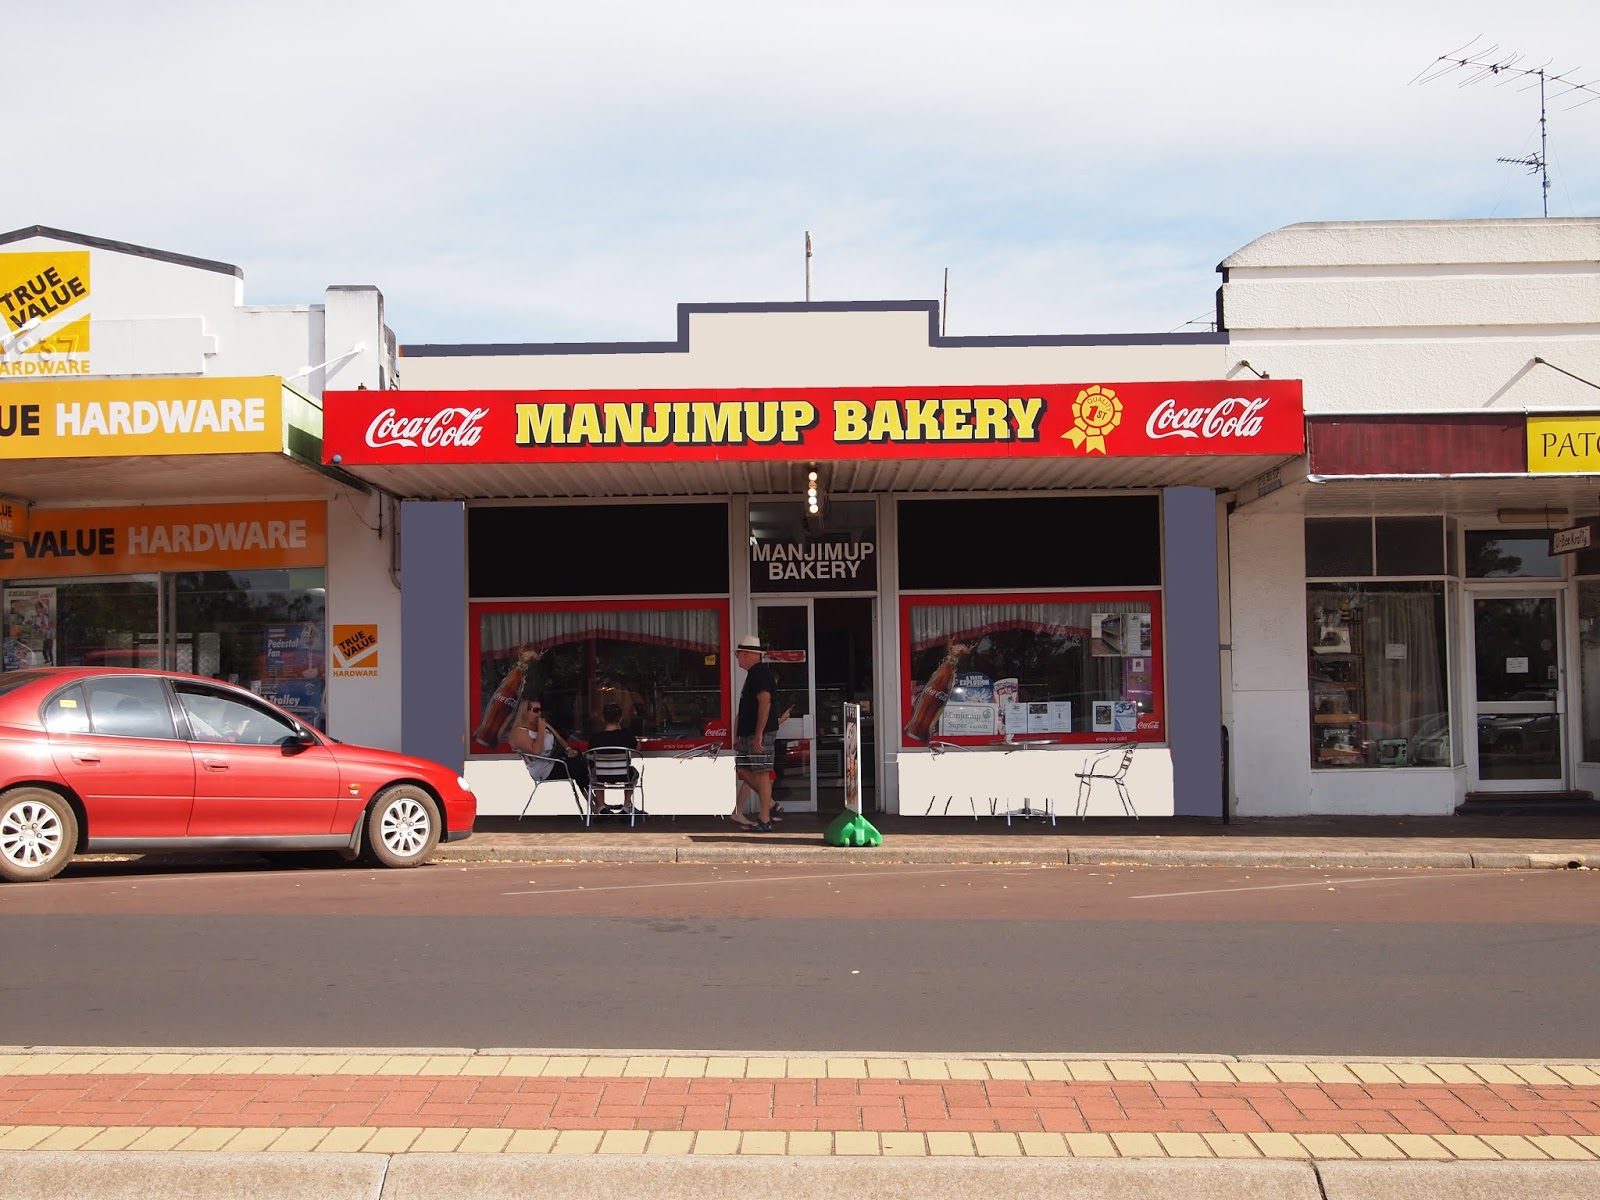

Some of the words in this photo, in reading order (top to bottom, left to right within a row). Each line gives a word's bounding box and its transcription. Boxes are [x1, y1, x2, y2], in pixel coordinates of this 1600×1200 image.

[0, 266, 62, 313] TRUE
[10, 276, 86, 328] VALUE
[1086, 397, 1112, 412] QUALITY
[56, 398, 265, 437] HARDWARE
[365, 407, 489, 448] Coca-Cola
[515, 401, 818, 446] MANJIMUP
[833, 398, 1046, 444] BAKERY
[1145, 397, 1270, 439] Coca-Cola
[1540, 432, 1600, 458] PAT
[0, 505, 12, 518] UE
[23, 528, 115, 559] VALUE
[128, 519, 306, 555] HARDWARE
[752, 542, 874, 561] MANJIMUP
[768, 560, 861, 580] BAKERY
[267, 638, 299, 648] Pedestal
[339, 630, 366, 650] TRUE
[343, 635, 376, 657] VALUE
[267, 649, 281, 657] Fan
[269, 694, 300, 707] Trolley
[944, 711, 981, 721] Manjimup
[948, 722, 967, 730] Super
